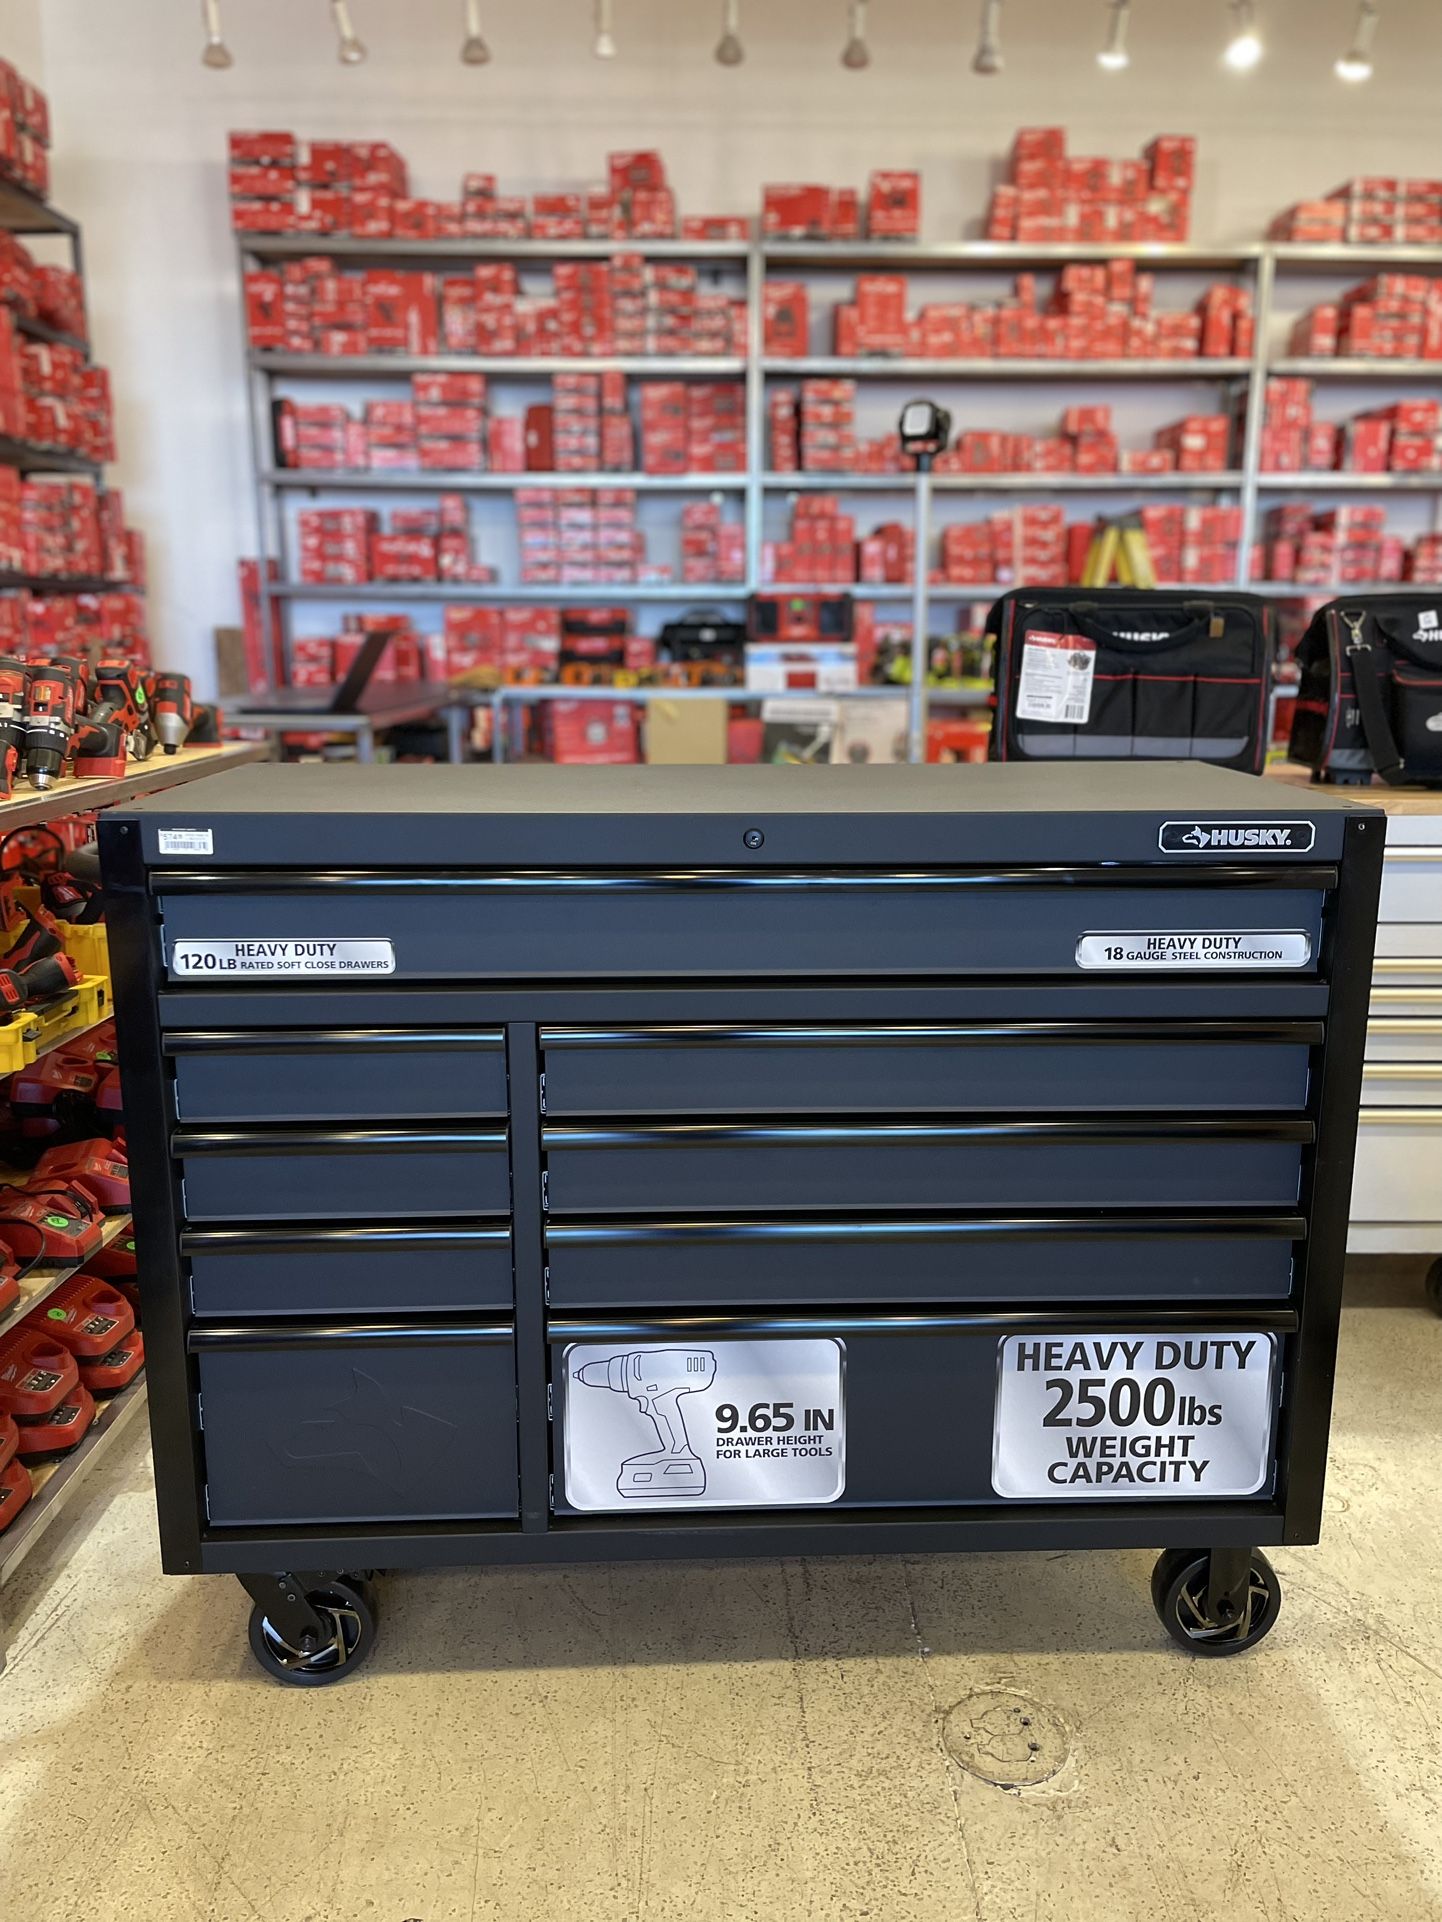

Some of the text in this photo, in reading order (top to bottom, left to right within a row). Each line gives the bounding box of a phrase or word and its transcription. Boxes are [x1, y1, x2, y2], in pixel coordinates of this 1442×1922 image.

[1210, 828, 1291, 846] HUSKY
[234, 943, 337, 957] HEAVY DUTY
[1146, 936, 1242, 950] HEAVY DUTY
[180, 953, 389, 970] 120 LB RATED SOFT CLOSE DRAWERS
[1104, 946, 1283, 961] 18 GAUGE STEEL CONSTRUCTION
[1016, 1340, 1257, 1372] HEAVY DUTY
[1042, 1376, 1223, 1428] 2500lbs
[715, 1402, 835, 1434] 9.65 IN
[716, 1434, 824, 1447] DRAWER HEIGHT
[1065, 1435, 1196, 1459] WEIGHT
[716, 1446, 833, 1460] FOR LARGE TOOLS
[1047, 1460, 1211, 1485] CAPACITY
